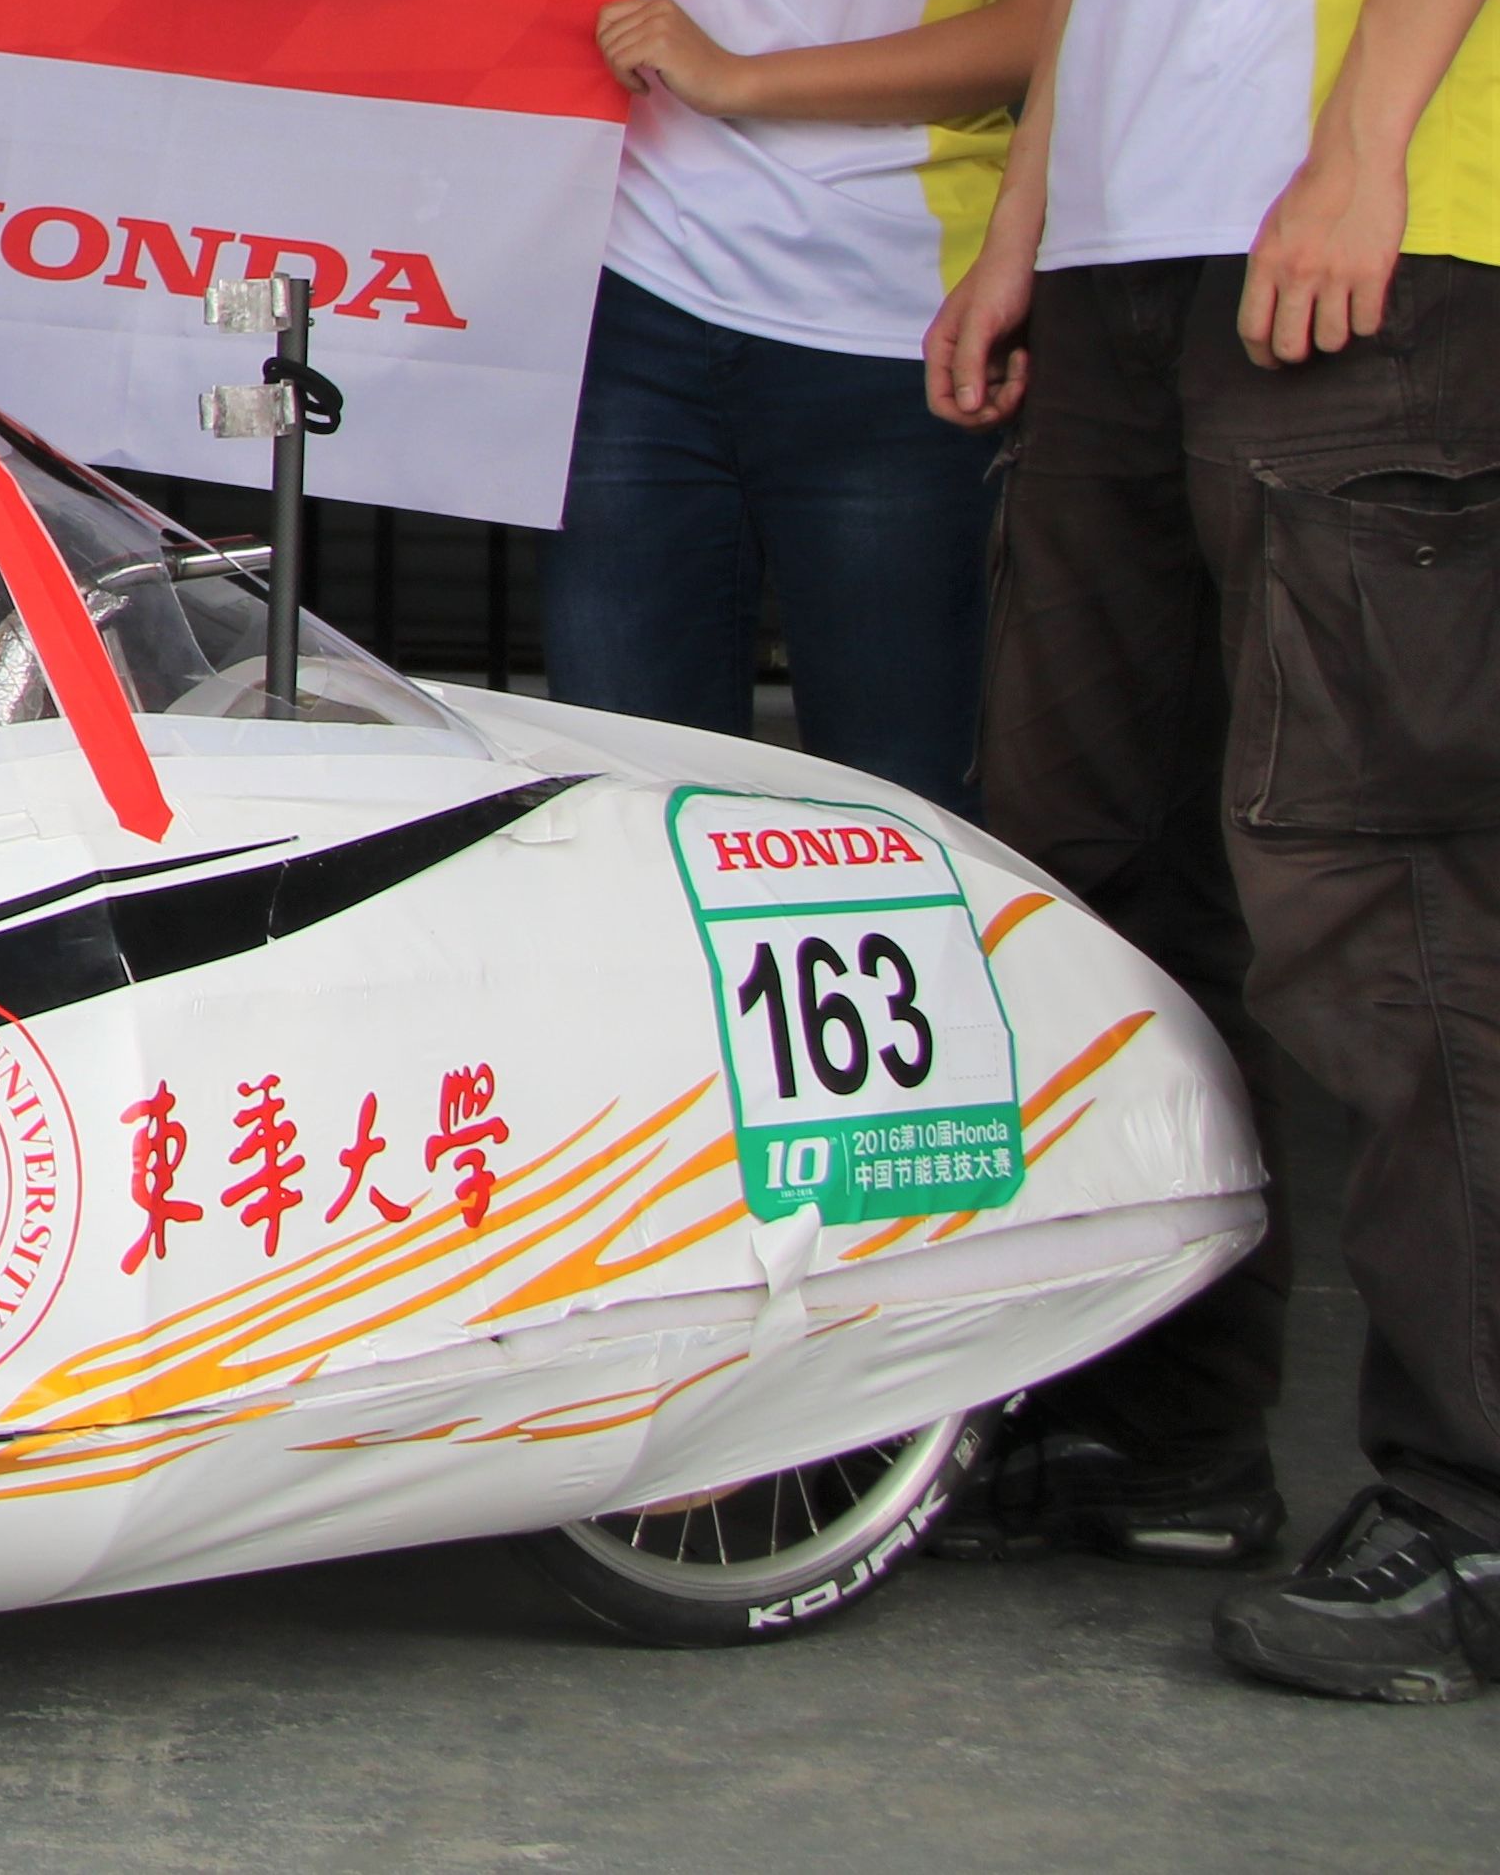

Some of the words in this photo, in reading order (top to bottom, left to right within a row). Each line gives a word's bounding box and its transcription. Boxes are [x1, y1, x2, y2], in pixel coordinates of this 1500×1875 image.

[707, 825, 924, 872] HONDA
[737, 932, 934, 1100] 163
[852, 1118, 1008, 1157] 2016第10届Honda
[854, 1147, 1012, 1192] 中国节能竞技大赛
[747, 1479, 949, 1629] KOJAK
